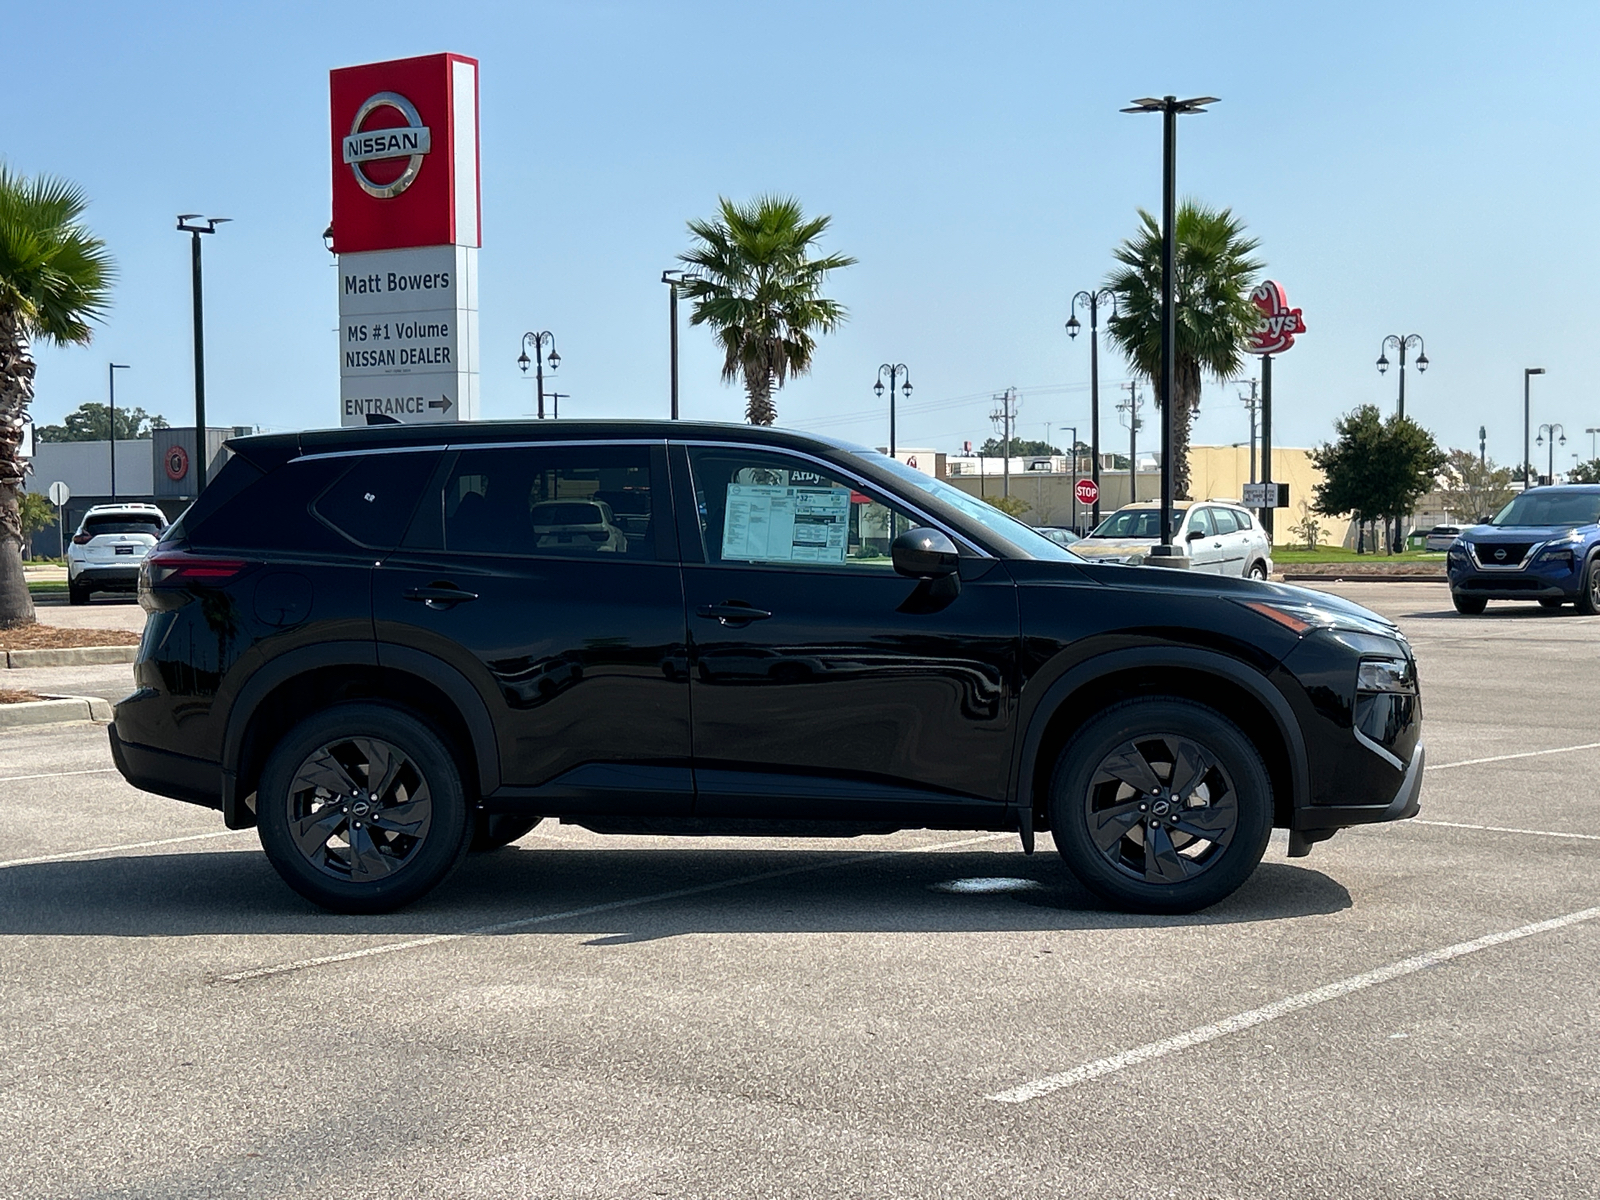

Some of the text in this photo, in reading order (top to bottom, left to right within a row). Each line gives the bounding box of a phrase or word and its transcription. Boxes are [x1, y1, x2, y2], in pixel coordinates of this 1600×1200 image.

[349, 133, 418, 157] NISSAN
[345, 272, 449, 295] Matt Bowers
[348, 321, 448, 342] MS #1 Volume
[346, 347, 451, 368] NISSAN DEALER
[345, 397, 424, 415] ENTRANCE
[1076, 486, 1097, 497] STOP
